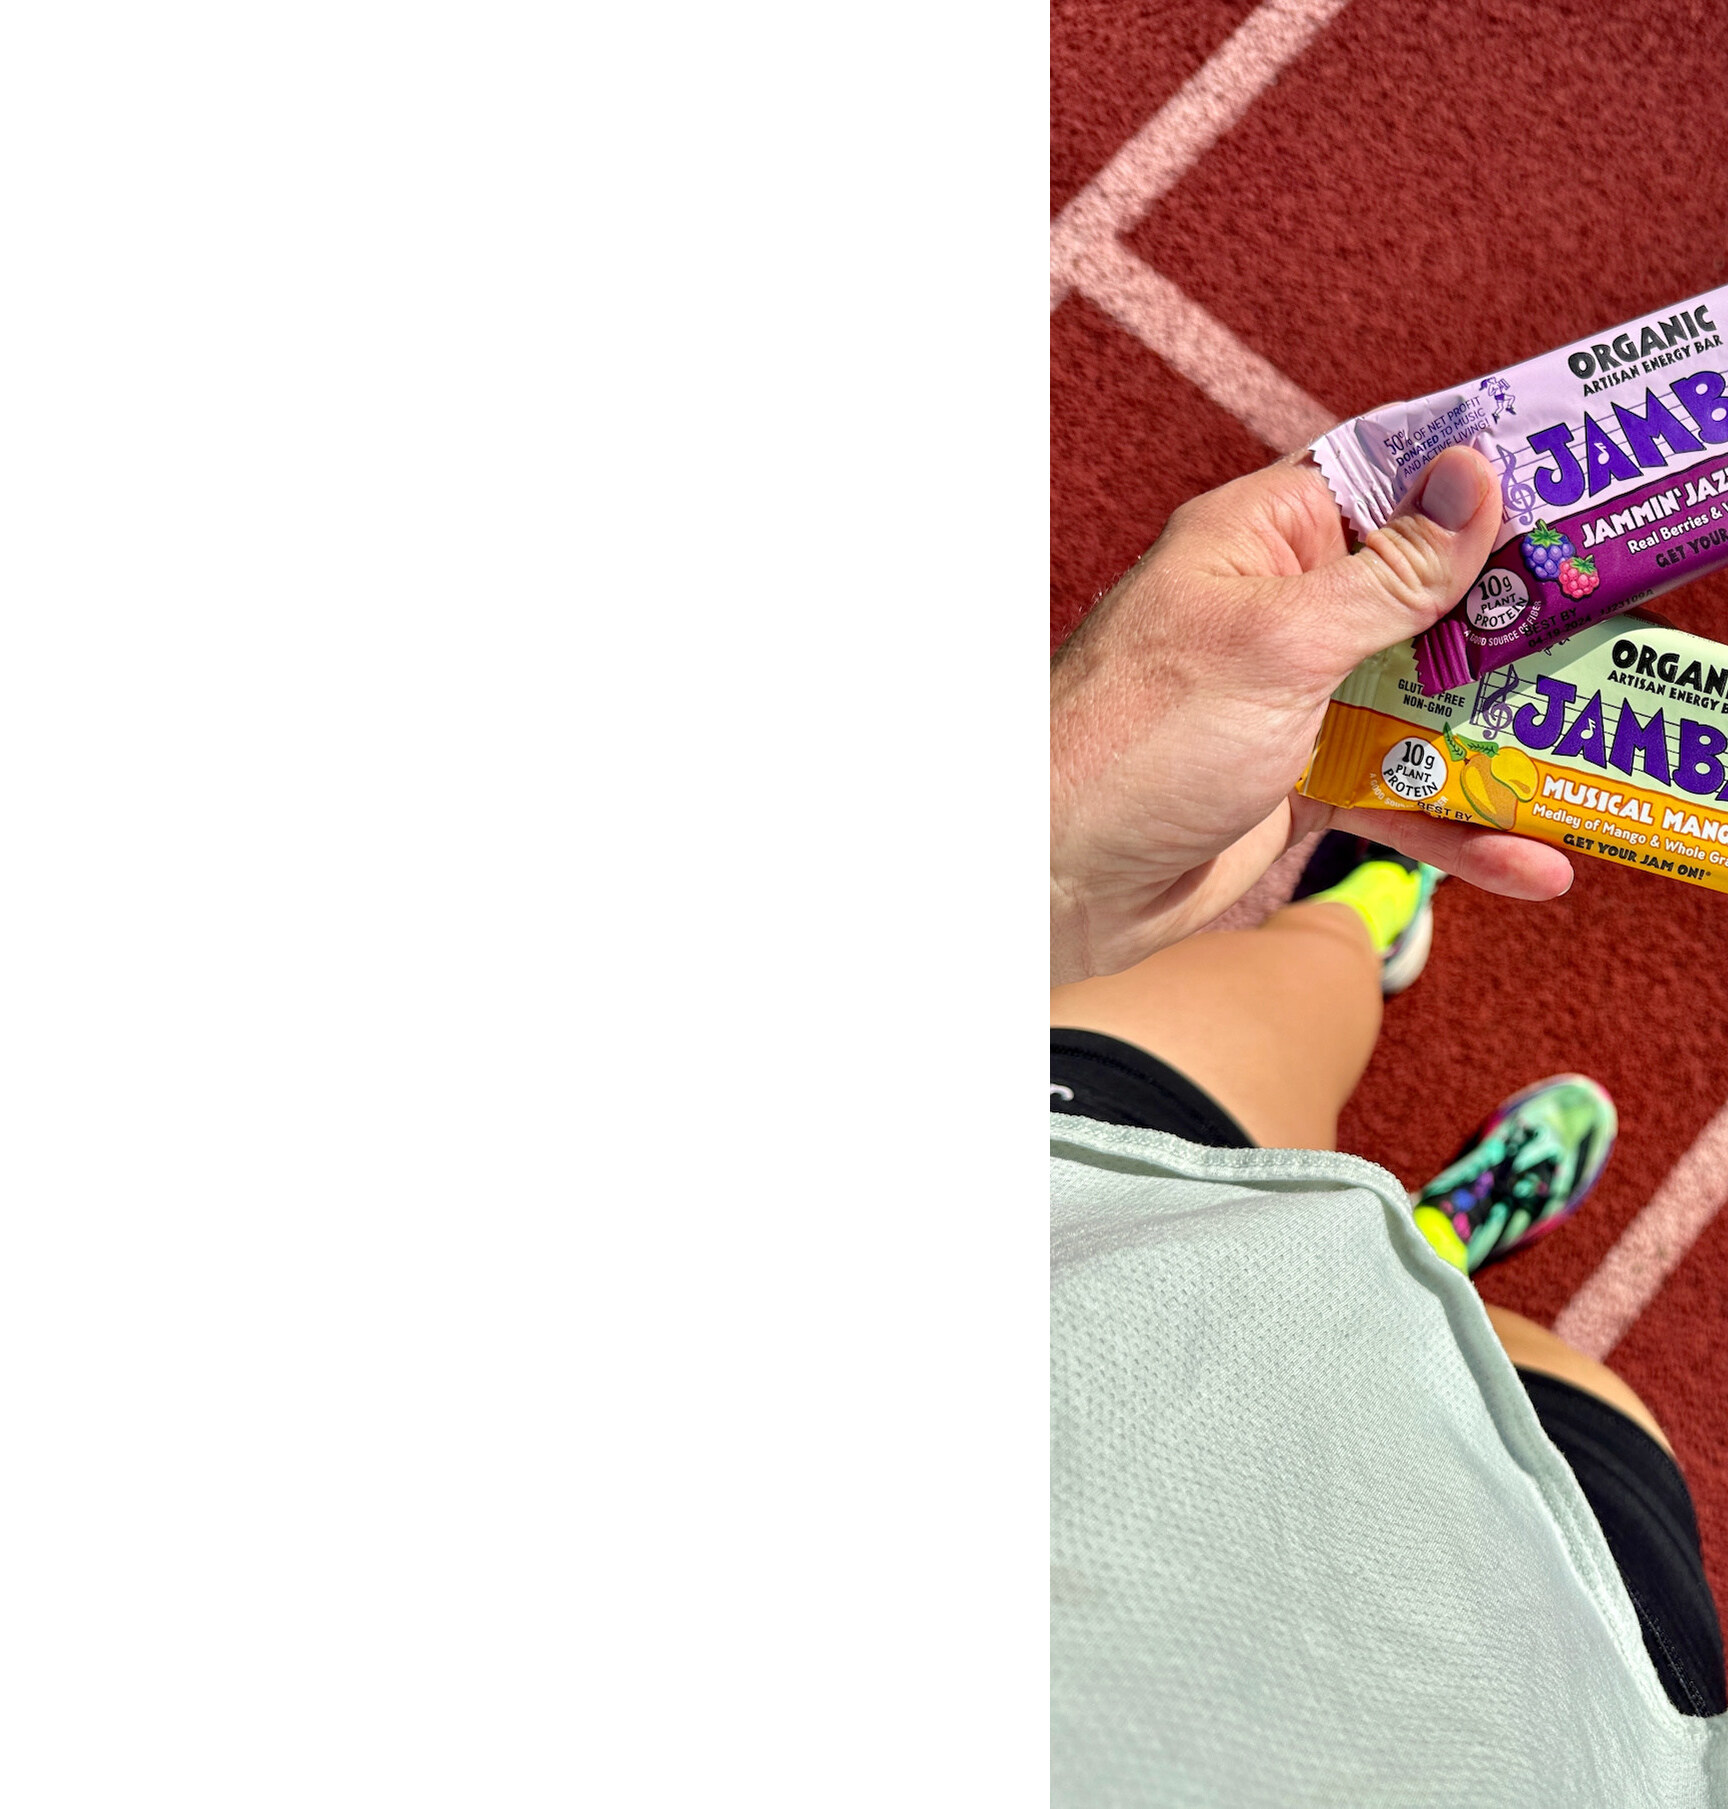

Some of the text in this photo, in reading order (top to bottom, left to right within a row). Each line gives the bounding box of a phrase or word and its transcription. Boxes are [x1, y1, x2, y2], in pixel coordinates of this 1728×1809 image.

[1567, 304, 1717, 380] ORGANIC
[1583, 334, 1724, 397] ARTISAN ENERGY BAR
[1384, 396, 1480, 455] 50% OF NET PROFIT
[1396, 408, 1486, 466] DONATED TO MUSIC
[1403, 457, 1422, 477] AND
[1454, 418, 1490, 444] LIVING!
[1581, 487, 1683, 548] JAMMIN'
[1627, 531, 1660, 555] Real
[1659, 513, 1710, 541] Berries
[1710, 506, 1723, 520] &
[1656, 544, 1686, 568] GET
[1474, 597, 1528, 628] PROTEIN
[1480, 593, 1516, 614] PLANT
[1487, 631, 1519, 647] SOURCE
[1526, 600, 1542, 629] FIBER
[1525, 608, 1577, 638] BEST BY
[1403, 694, 1453, 718] NON-GMO
[1607, 670, 1666, 696] ARTISAN
[1669, 687, 1720, 711] ENERGY
[1383, 768, 1438, 798] PROTEIN
[1395, 764, 1432, 783] PLANT
[1417, 801, 1451, 816] BEST
[1455, 811, 1473, 821] BY
[1542, 774, 1654, 825] MUSICAL
[1532, 803, 1581, 830] Medley
[1584, 818, 1601, 832] of
[1602, 824, 1647, 849] Mango
[1650, 835, 1661, 848] &
[1665, 838, 1706, 861] Whole
[1563, 833, 1705, 880] GET YOUR JAM ON!
